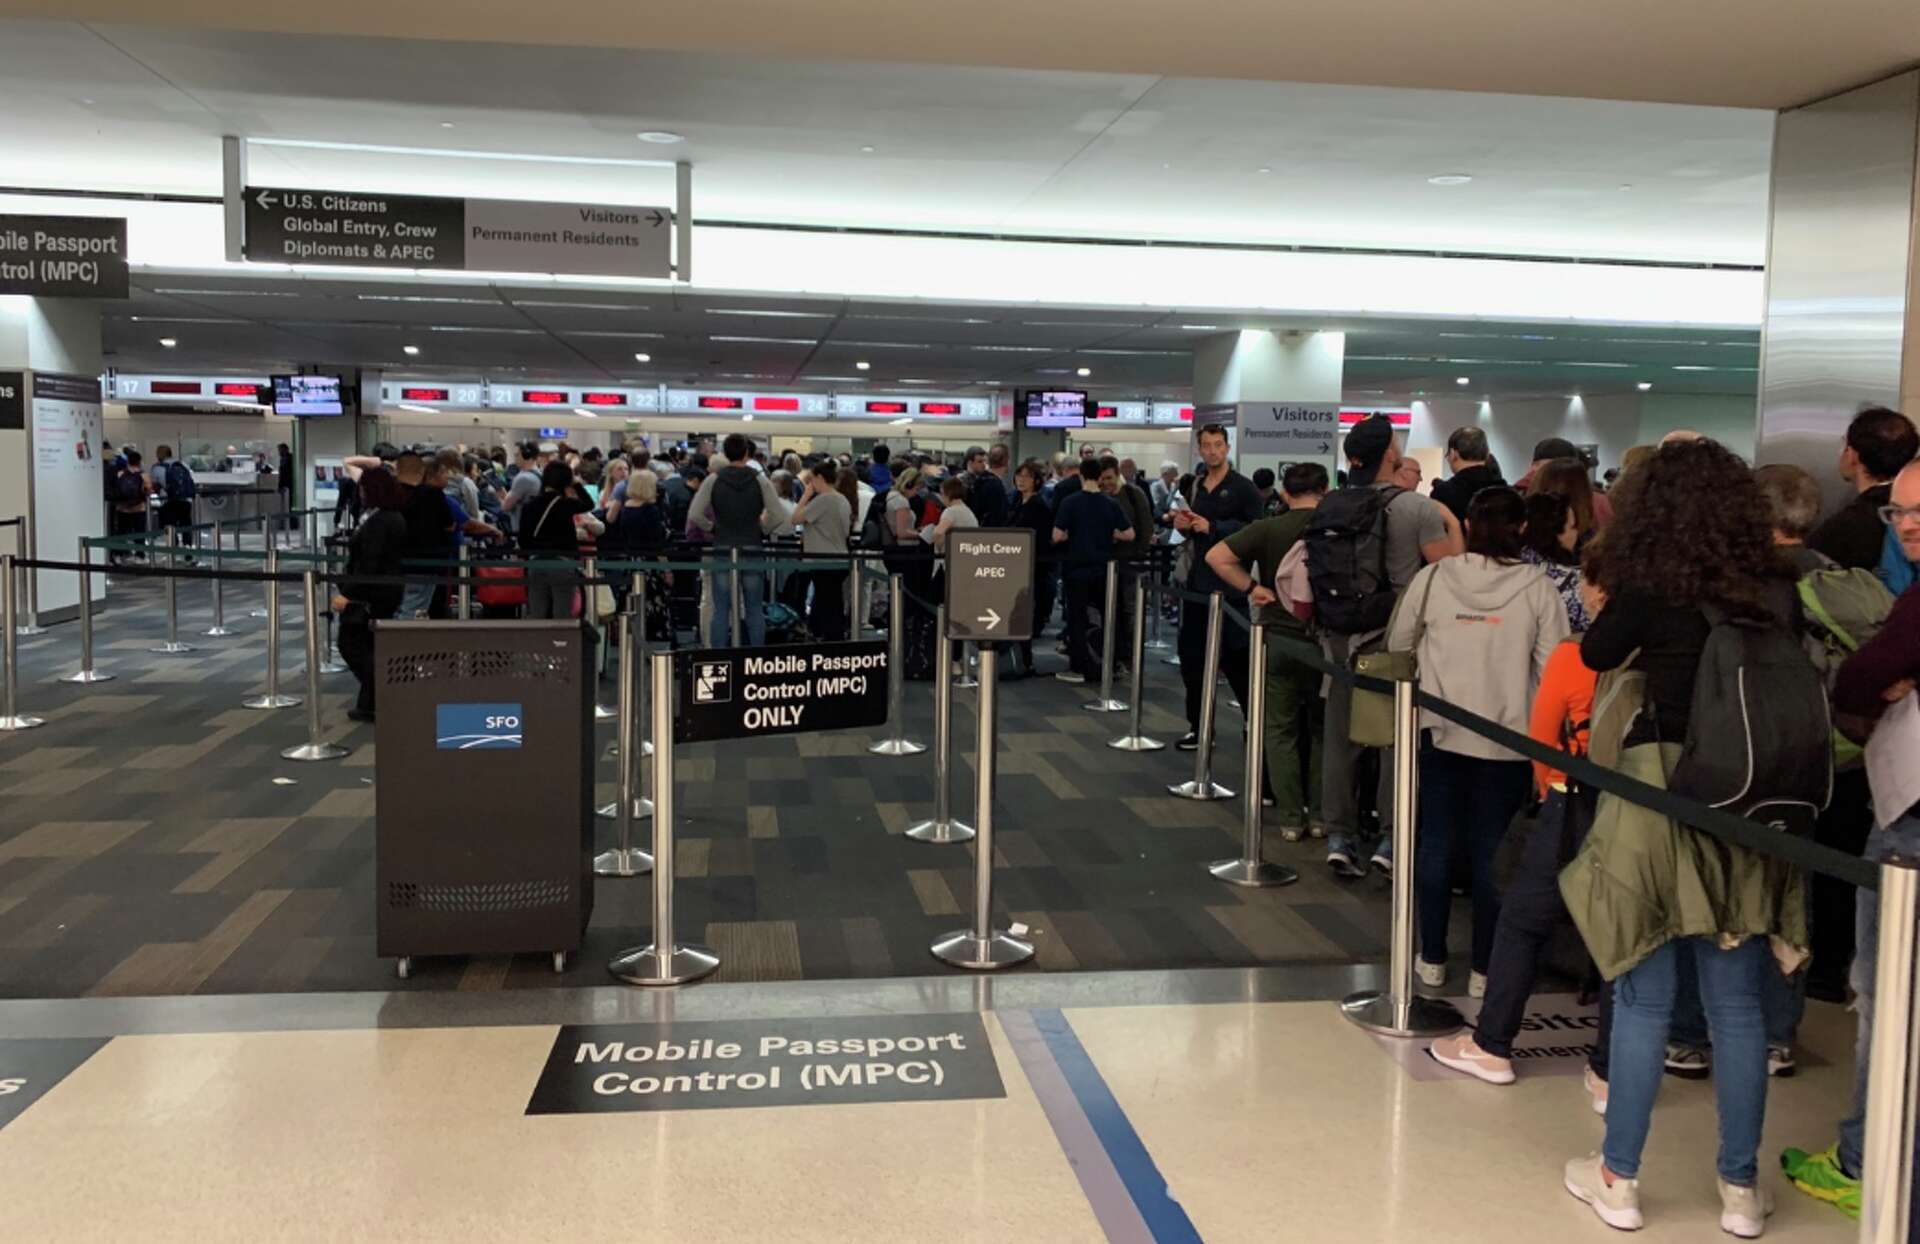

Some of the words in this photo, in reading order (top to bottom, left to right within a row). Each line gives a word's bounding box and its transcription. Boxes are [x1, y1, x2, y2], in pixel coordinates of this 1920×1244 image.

[283, 193, 317, 210] U.S.
[321, 196, 387, 212] Citizens
[579, 208, 639, 224] Visitors
[283, 216, 338, 233] Global
[343, 219, 390, 237] Entry,
[394, 222, 437, 237] Crew
[34, 231, 118, 256] Passport
[471, 226, 557, 243] Permanent
[562, 230, 639, 247] Residents
[283, 240, 368, 257] Diplomats
[373, 243, 386, 258] &
[390, 245, 435, 260] APEC
[41, 260, 98, 284] (MPC)
[123, 380, 138, 393] 17
[458, 389, 477, 402] 20
[496, 390, 513, 402] 21
[636, 394, 654, 407] 22
[672, 395, 689, 408] 23
[807, 399, 824, 412] 24
[839, 400, 857, 412] 25
[1125, 406, 1142, 419] 28
[1156, 407, 1173, 420] 29
[1272, 408, 1333, 423] Visitors
[1244, 427, 1290, 440] Permanent
[1292, 428, 1333, 440] Residents
[960, 543, 991, 555] Flight
[993, 543, 1022, 554] Crew
[974, 567, 1006, 578] APEC
[744, 655, 807, 675] Mobile
[812, 652, 887, 673] Passport
[743, 680, 811, 701] Control
[816, 675, 867, 698] (MPC)
[485, 716, 519, 729] SFO
[743, 705, 805, 729] ONLY
[574, 1037, 742, 1064] Mobile
[758, 1031, 966, 1058] Passport
[592, 1066, 781, 1096] Control
[799, 1060, 945, 1091] (MPC)
